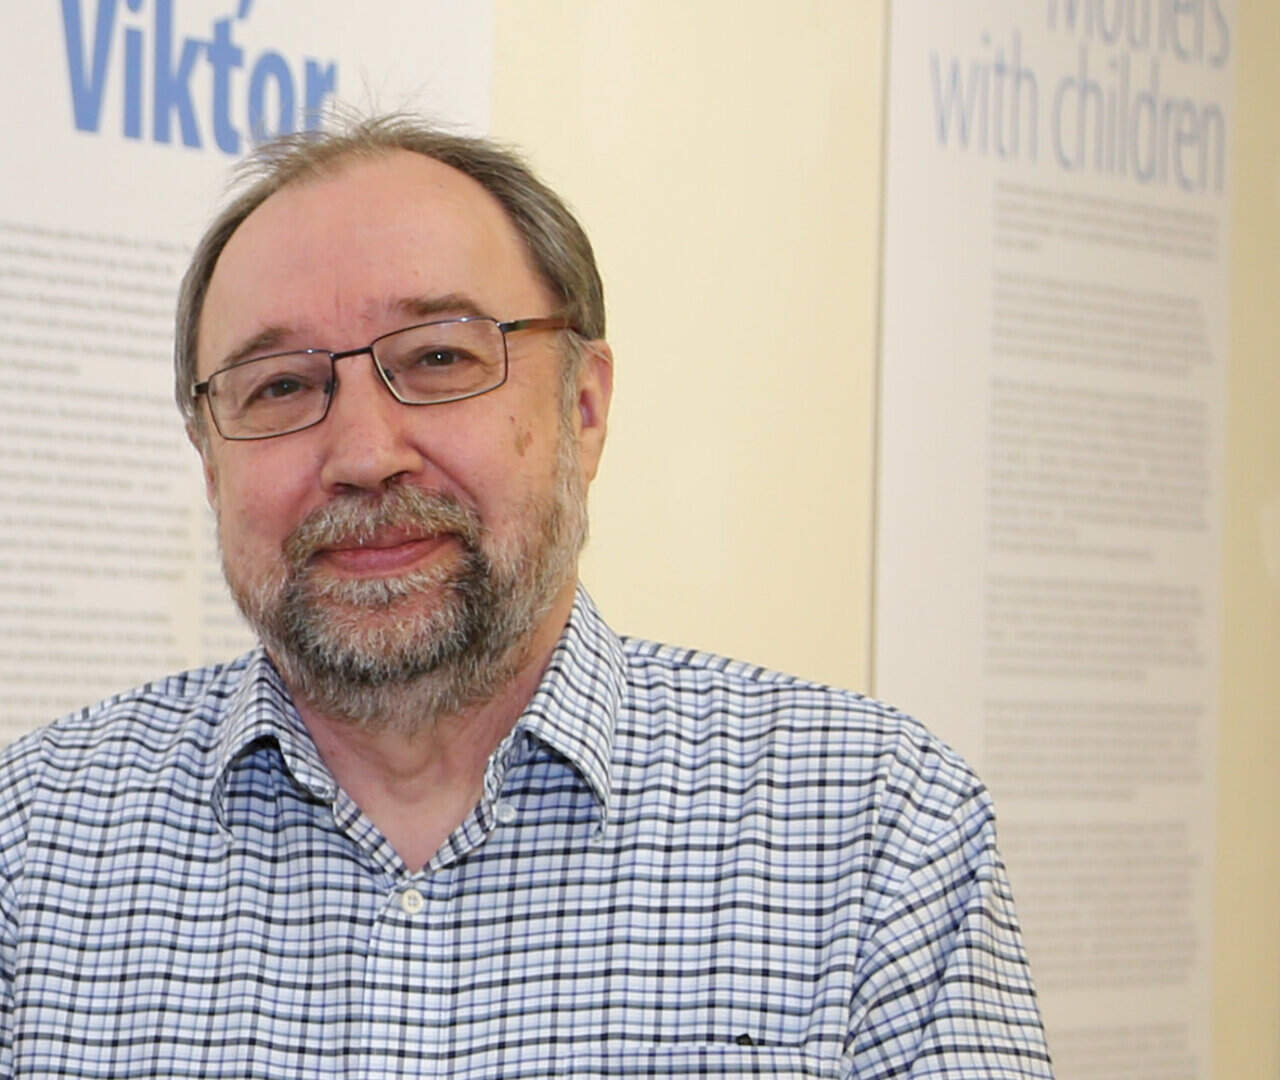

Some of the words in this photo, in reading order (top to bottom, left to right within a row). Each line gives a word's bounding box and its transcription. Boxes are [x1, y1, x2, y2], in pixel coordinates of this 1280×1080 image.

[59, 0, 337, 156] Viktor
[929, 27, 1040, 163] with
[1051, 40, 1226, 195] children
